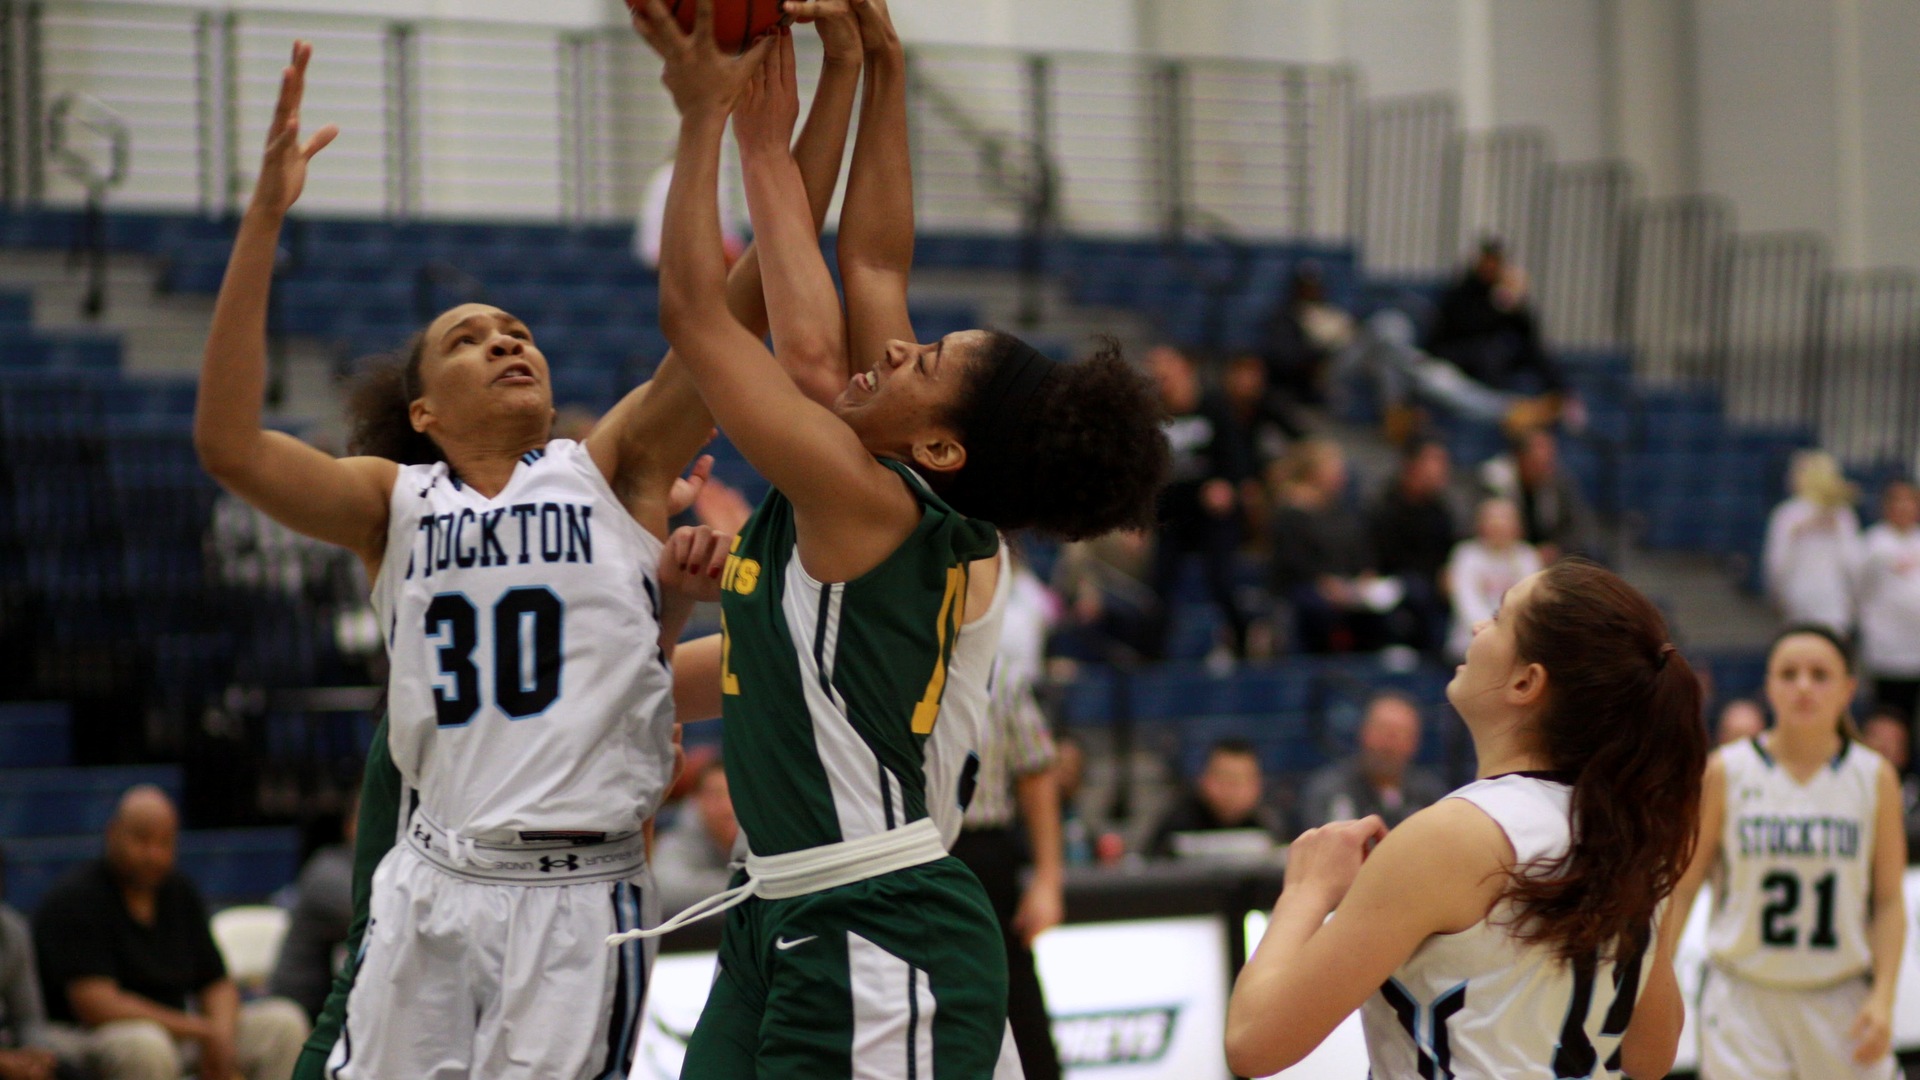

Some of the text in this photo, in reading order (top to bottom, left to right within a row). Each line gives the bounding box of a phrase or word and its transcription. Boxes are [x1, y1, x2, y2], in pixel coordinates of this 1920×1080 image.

[405, 503, 593, 580] TOCKTON
[424, 584, 565, 729] 30
[493, 861, 534, 871] UNDE
[1738, 814, 1859, 858] STOCKTON
[1761, 868, 1838, 948] 21
